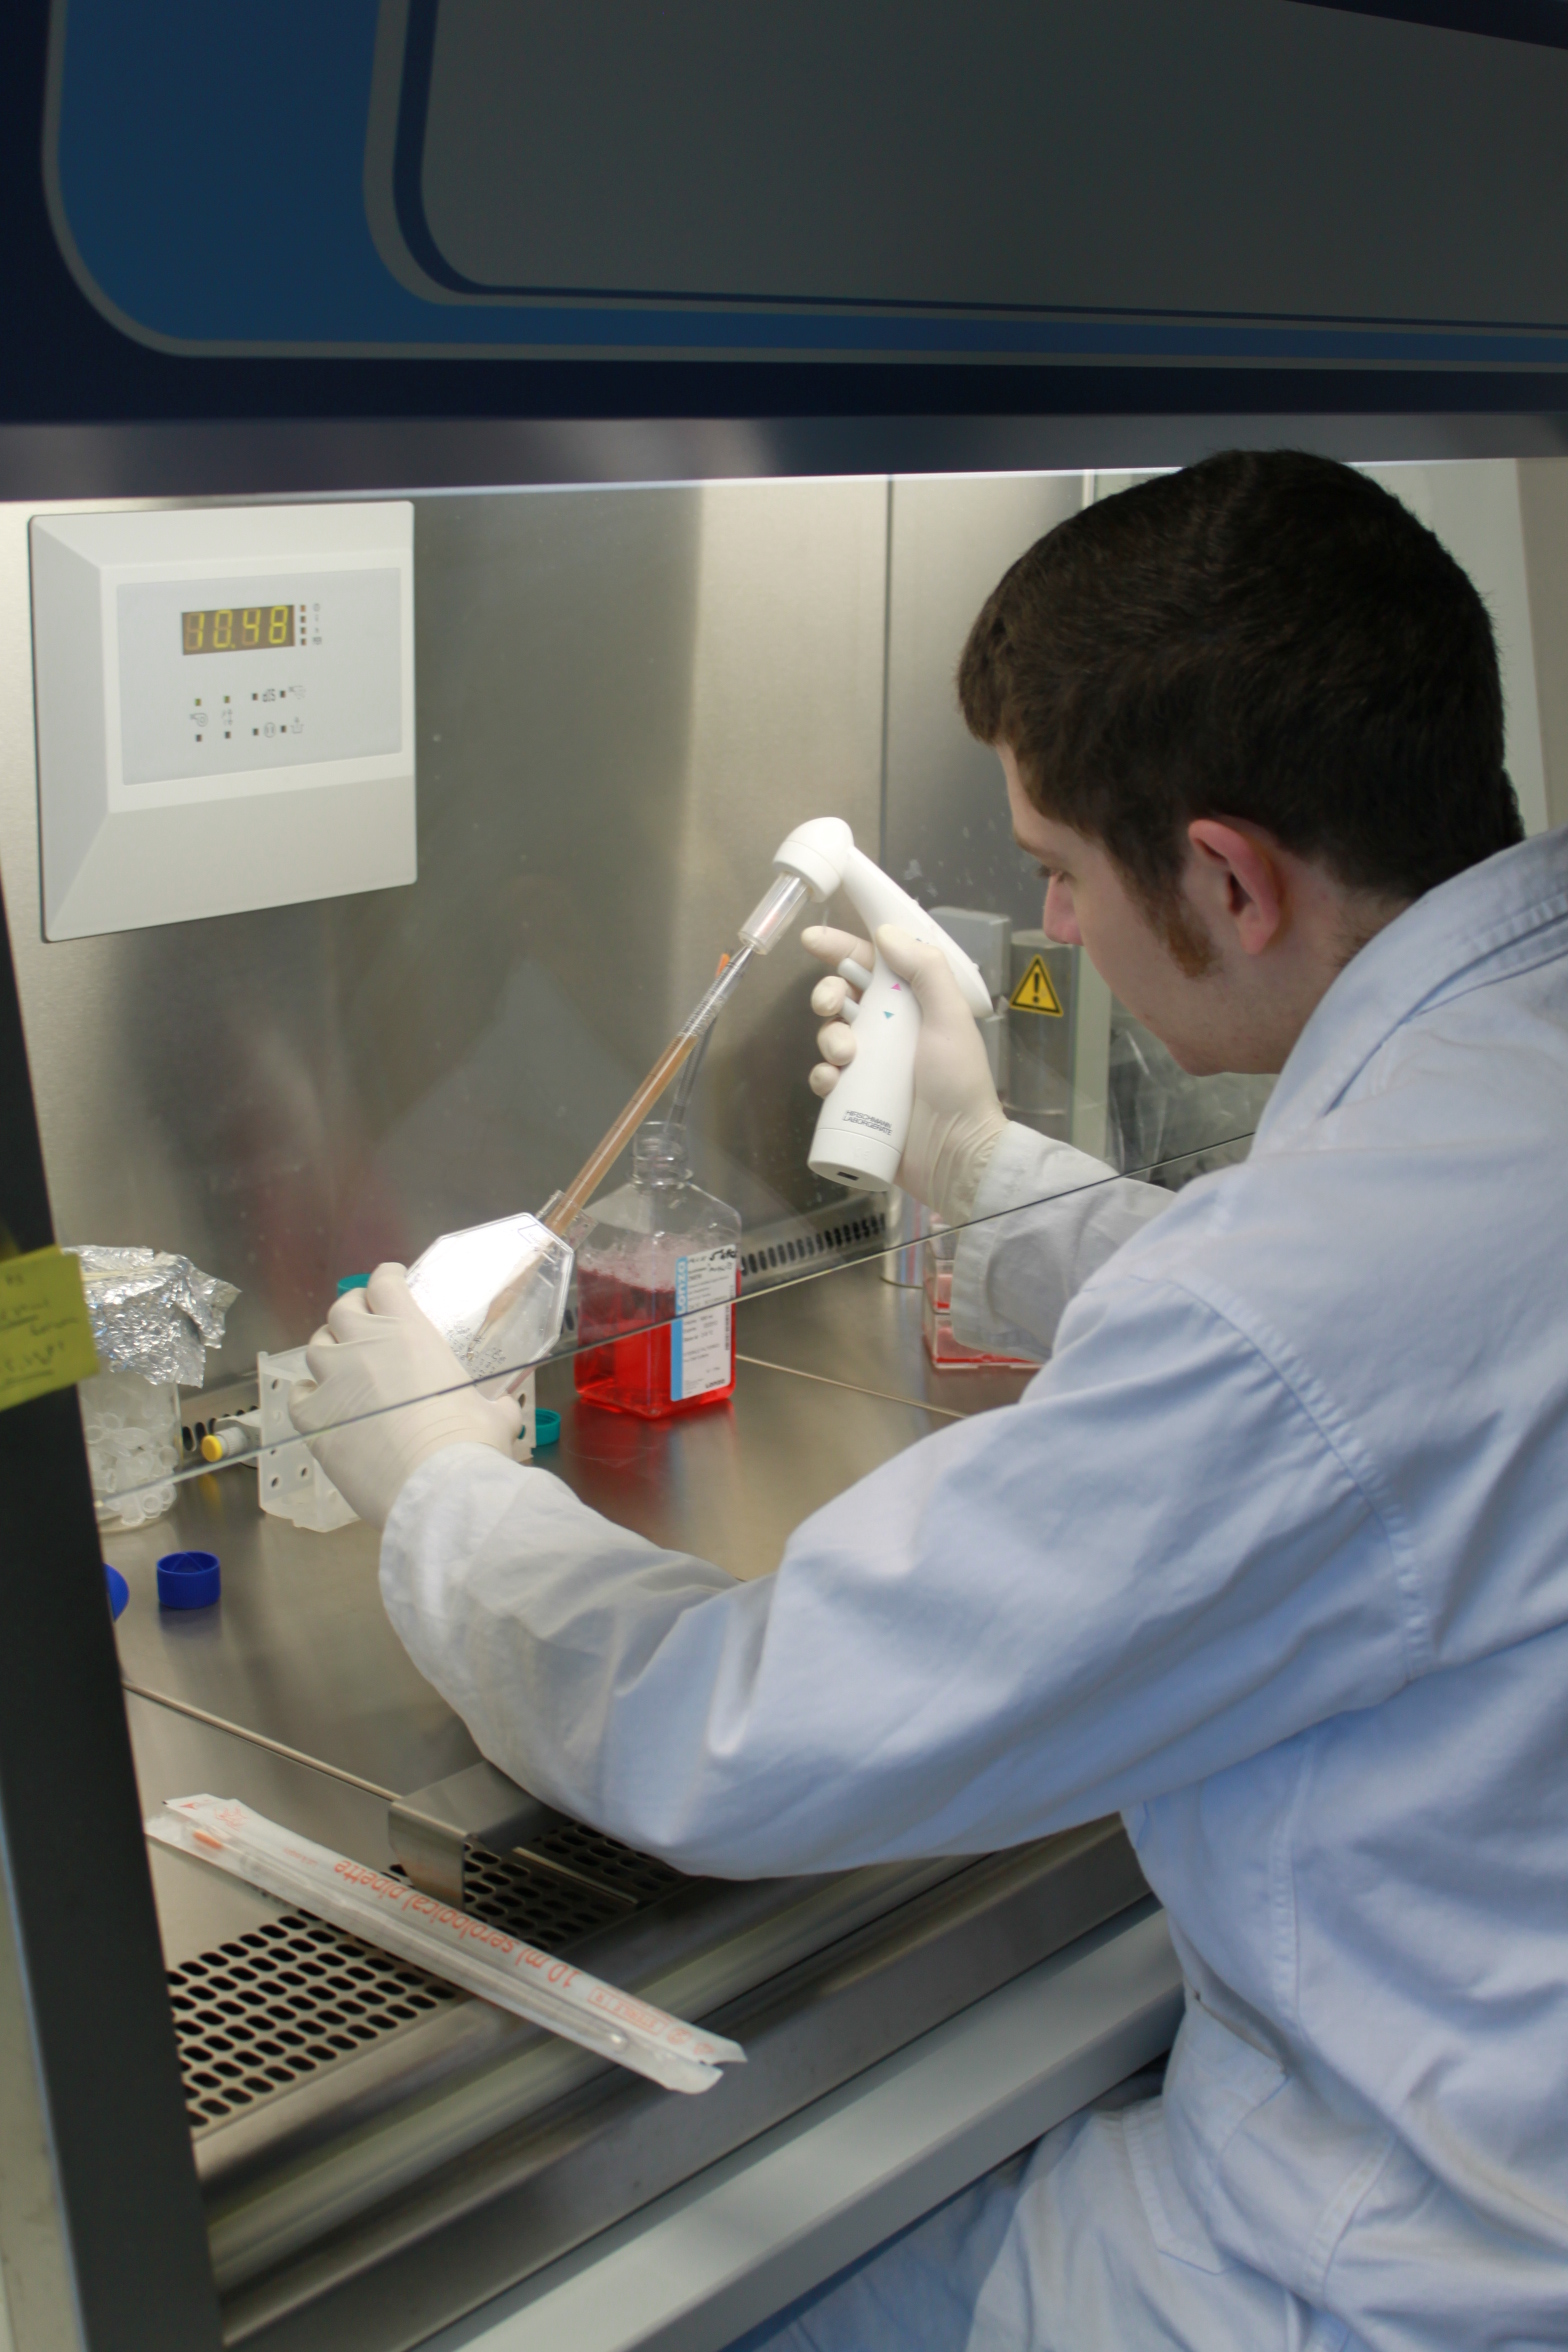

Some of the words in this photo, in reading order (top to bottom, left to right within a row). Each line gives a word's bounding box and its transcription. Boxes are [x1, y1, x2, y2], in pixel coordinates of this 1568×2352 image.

[846, 1110, 892, 1128] HIRSCHMANN
[334, 1859, 411, 1899] pipette
[402, 1893, 520, 1953] serological
[515, 1947, 551, 1969] ml
[547, 1962, 582, 1989] 10
